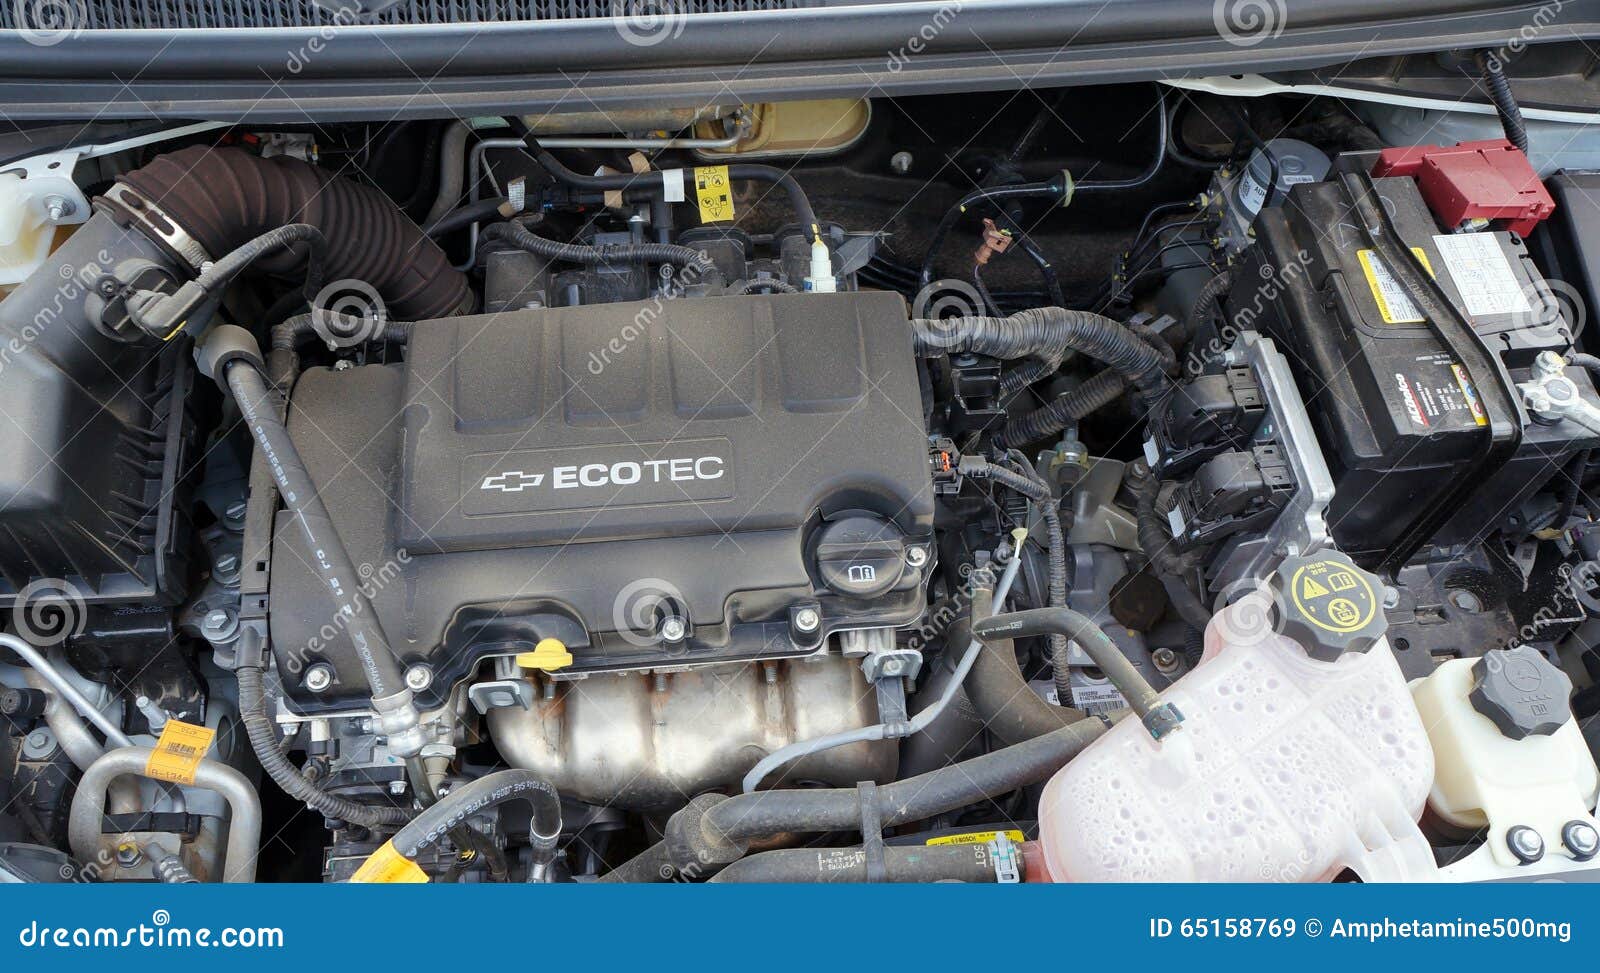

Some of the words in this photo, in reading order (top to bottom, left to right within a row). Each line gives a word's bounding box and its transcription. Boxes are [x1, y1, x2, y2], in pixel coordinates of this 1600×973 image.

[1395, 372, 1425, 425] ACDelco
[553, 456, 724, 489] ECOTEC
[465, 796, 489, 814] TYPE
